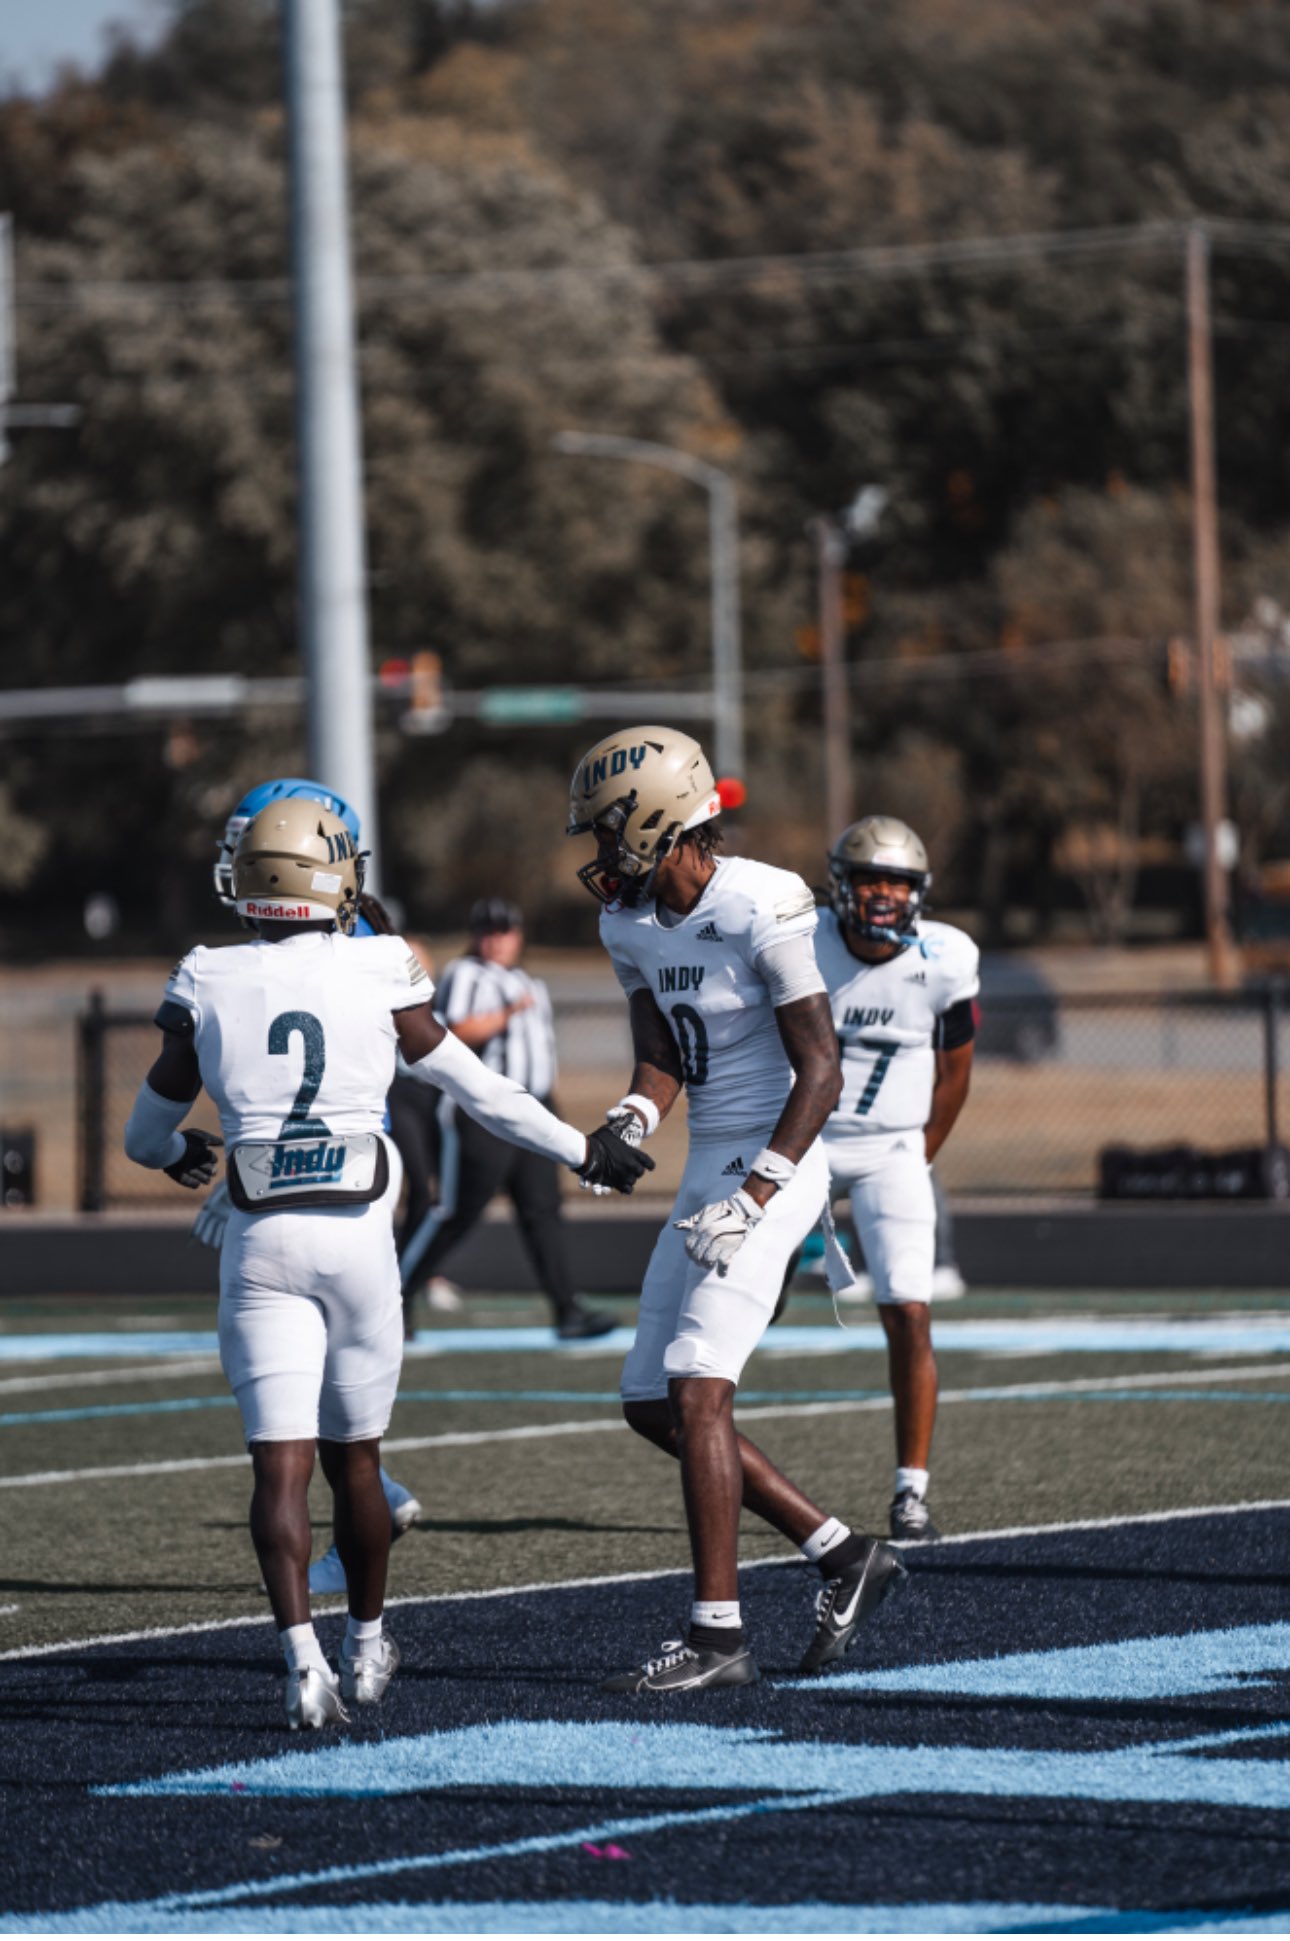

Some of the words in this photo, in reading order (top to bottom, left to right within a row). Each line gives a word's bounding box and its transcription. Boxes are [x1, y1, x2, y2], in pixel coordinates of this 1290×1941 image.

[584, 745, 646, 791] INDY
[246, 902, 310, 919] Riddell
[658, 966, 704, 992] INDY
[842, 1006, 894, 1026] INDY
[268, 1010, 326, 1140] 2
[270, 1141, 346, 1184] Indy
